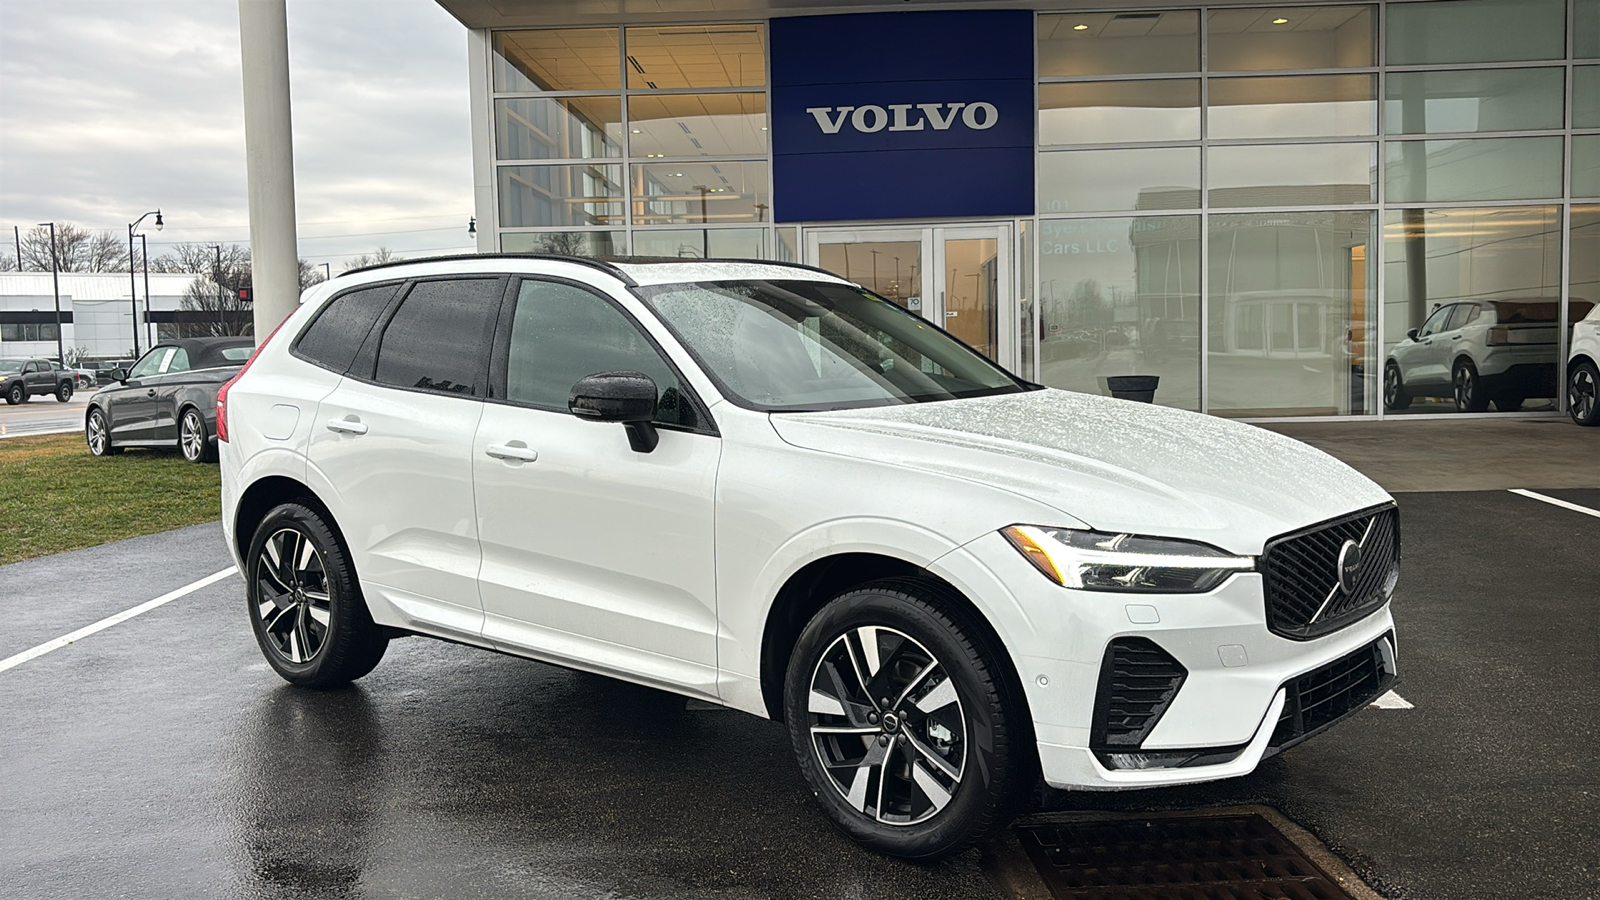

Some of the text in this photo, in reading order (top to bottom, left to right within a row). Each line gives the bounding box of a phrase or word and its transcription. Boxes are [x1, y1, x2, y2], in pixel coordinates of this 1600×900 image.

[806, 101, 999, 134] VOLVO
[1041, 239, 1119, 254] Cars LLC
